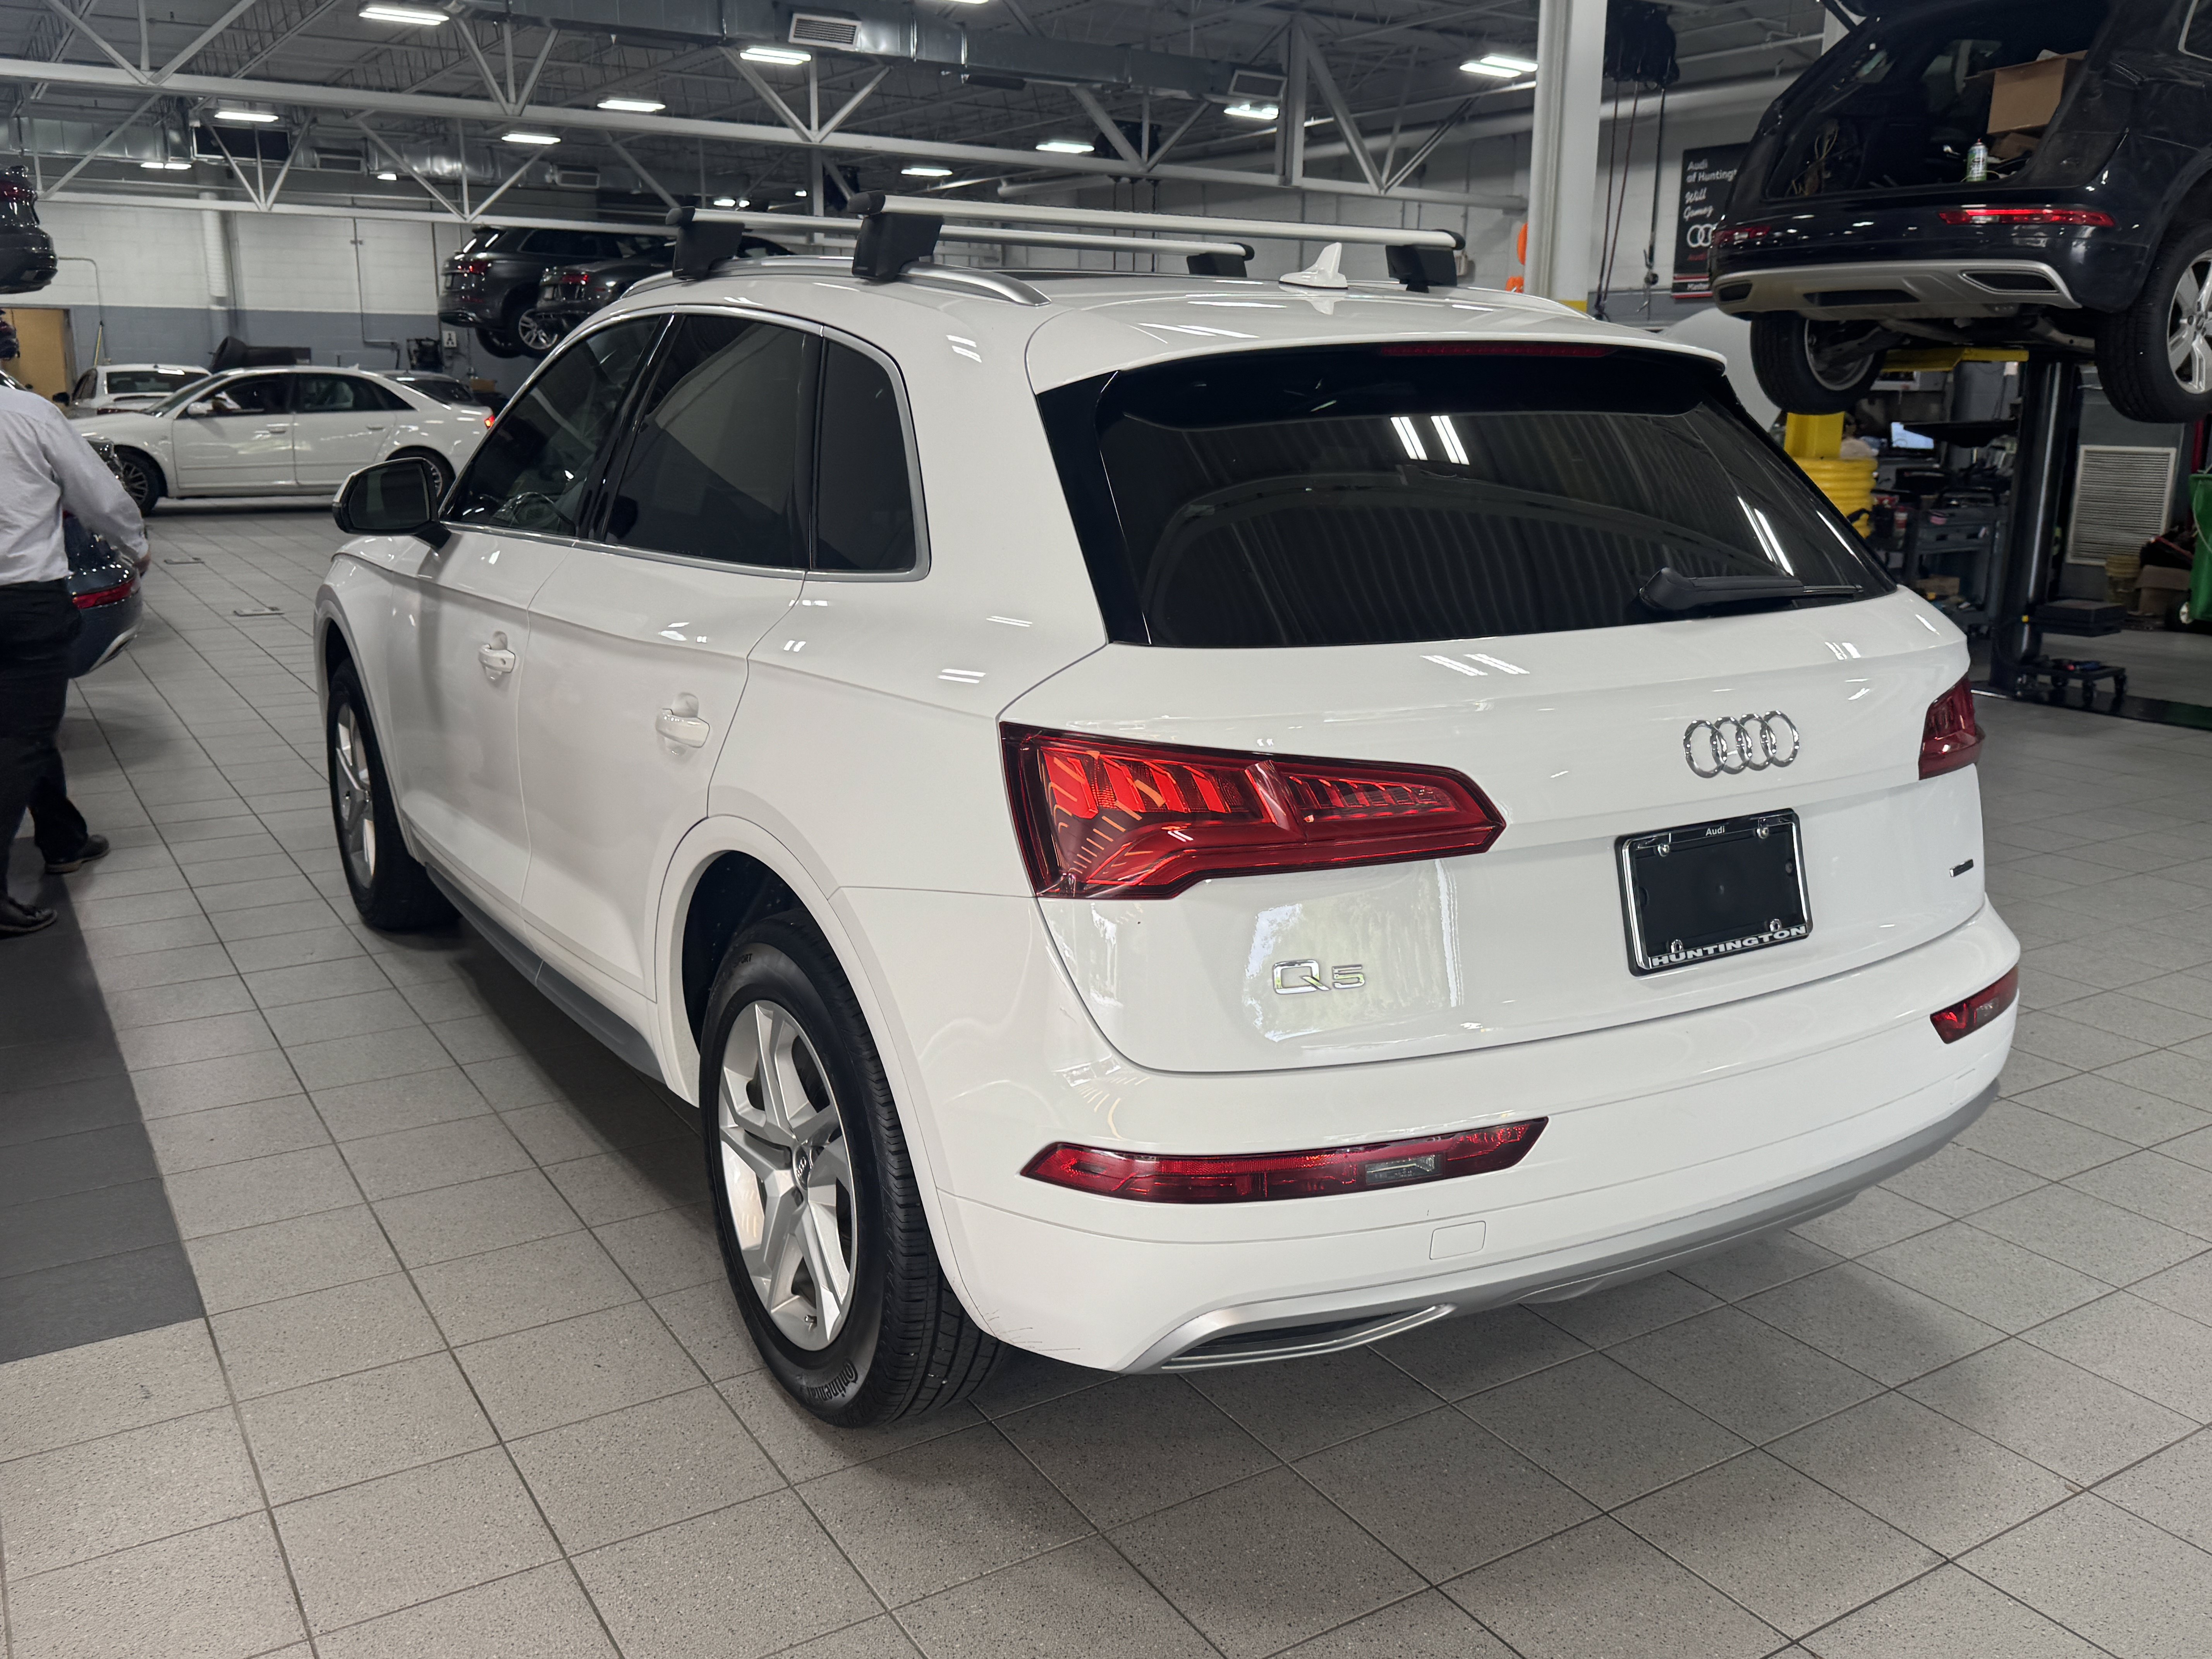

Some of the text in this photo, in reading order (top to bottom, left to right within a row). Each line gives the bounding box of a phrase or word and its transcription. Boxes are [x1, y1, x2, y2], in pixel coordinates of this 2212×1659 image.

[1686, 170, 1738, 183] of Huntingt
[1687, 158, 1708, 170] Audi
[1705, 826, 1725, 837] Audi
[1652, 926, 1807, 967] HUNTINGTON
[1272, 958, 1366, 995] Q5
[807, 1358, 859, 1401] Continental
